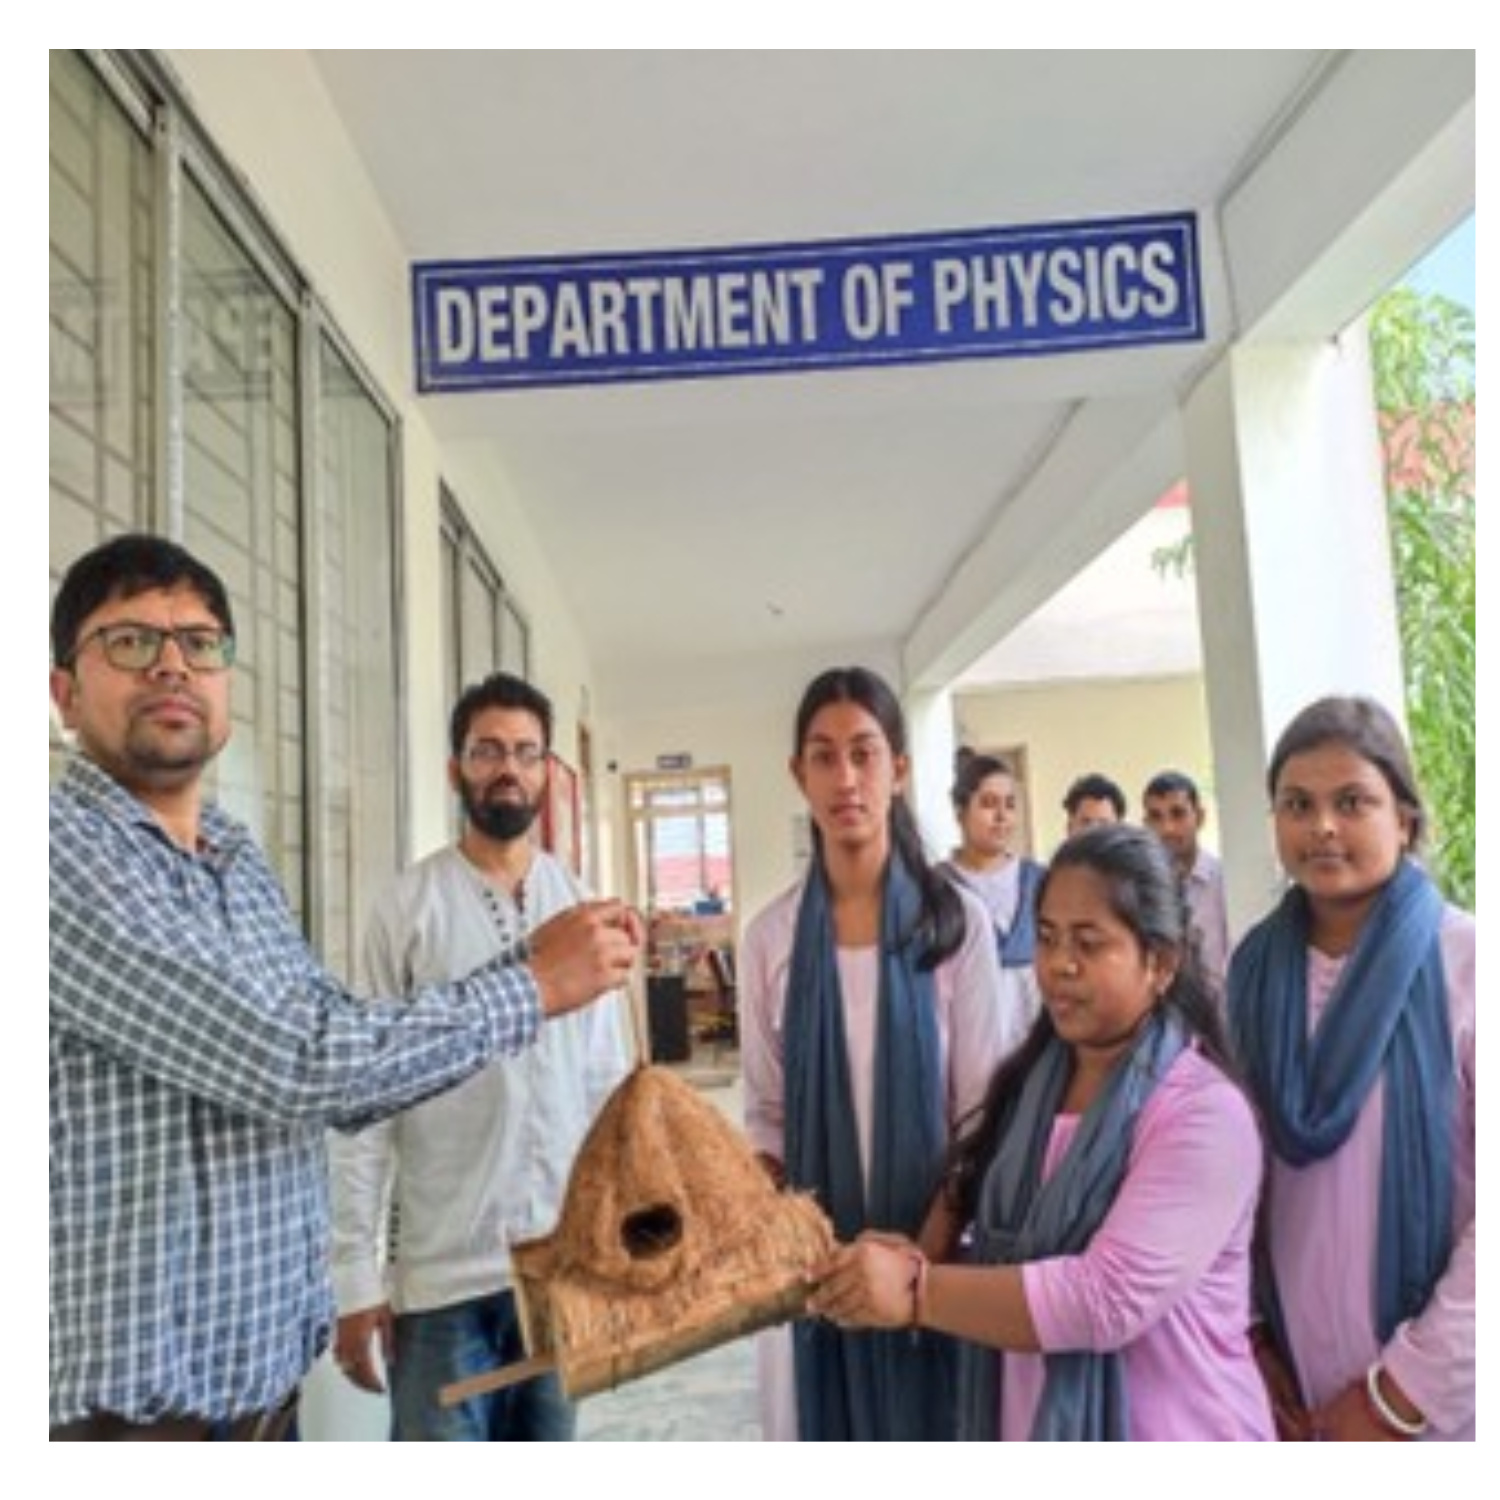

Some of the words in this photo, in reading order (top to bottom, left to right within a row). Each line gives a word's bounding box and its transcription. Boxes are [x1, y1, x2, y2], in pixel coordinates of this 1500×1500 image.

[436, 267, 824, 364] DEPARTMENT
[841, 261, 915, 341] OF
[932, 242, 1180, 334] PHYSICS
